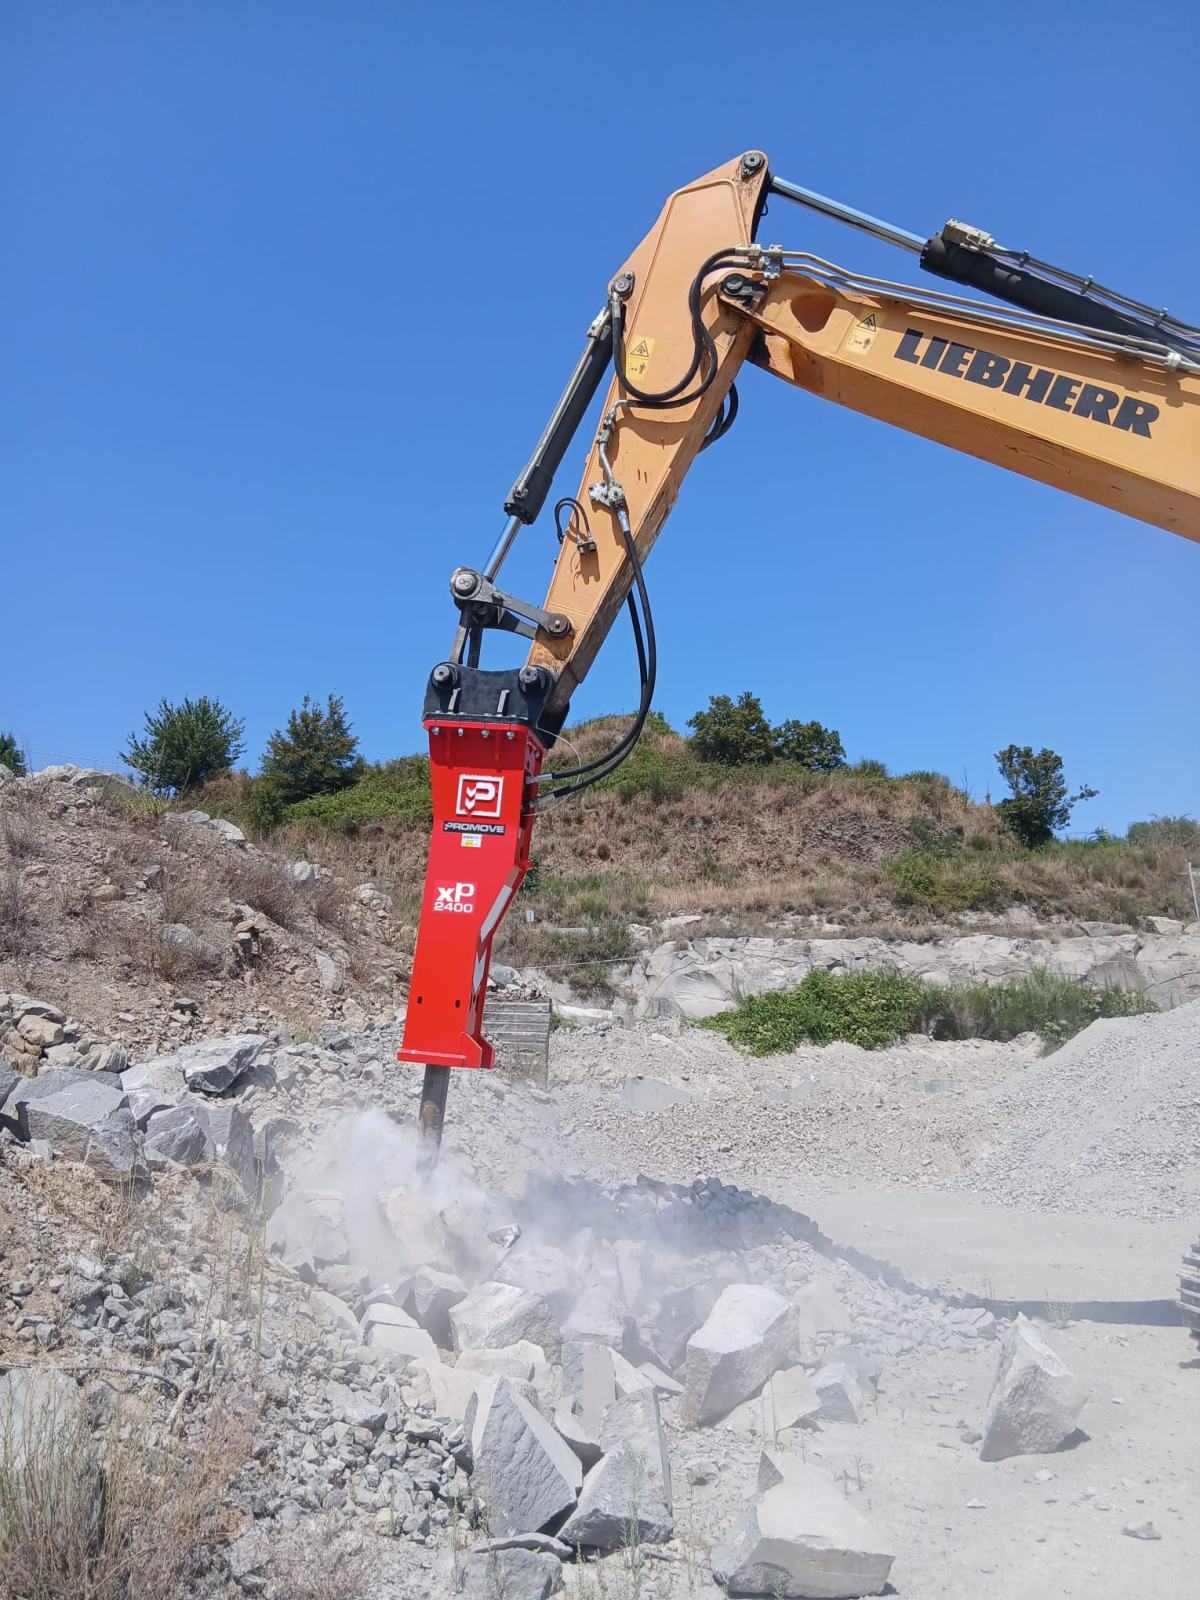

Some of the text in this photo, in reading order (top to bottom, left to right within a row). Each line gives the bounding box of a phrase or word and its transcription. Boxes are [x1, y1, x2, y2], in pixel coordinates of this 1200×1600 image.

[894, 328, 1160, 439] LIEBHERR
[444, 822, 505, 833] PROMOVE
[434, 901, 473, 913] 2400
